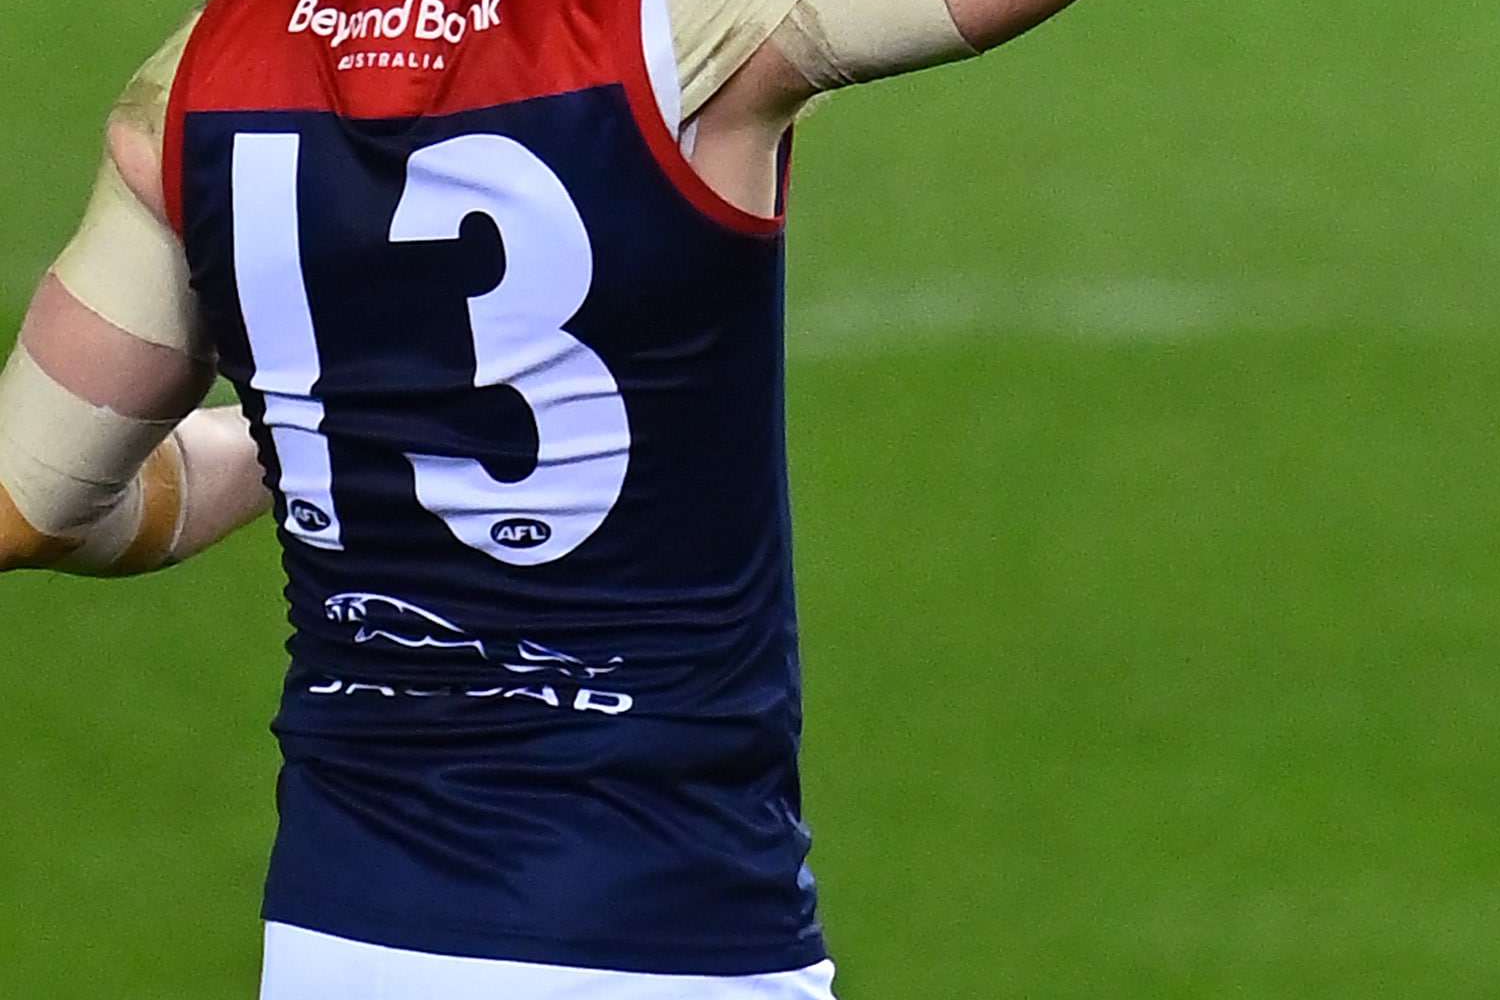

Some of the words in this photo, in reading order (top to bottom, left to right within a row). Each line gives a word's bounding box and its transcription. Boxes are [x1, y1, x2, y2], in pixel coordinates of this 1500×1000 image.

[231, 133, 631, 566] 13
[294, 505, 328, 526] AFL
[496, 525, 547, 542] AFL
